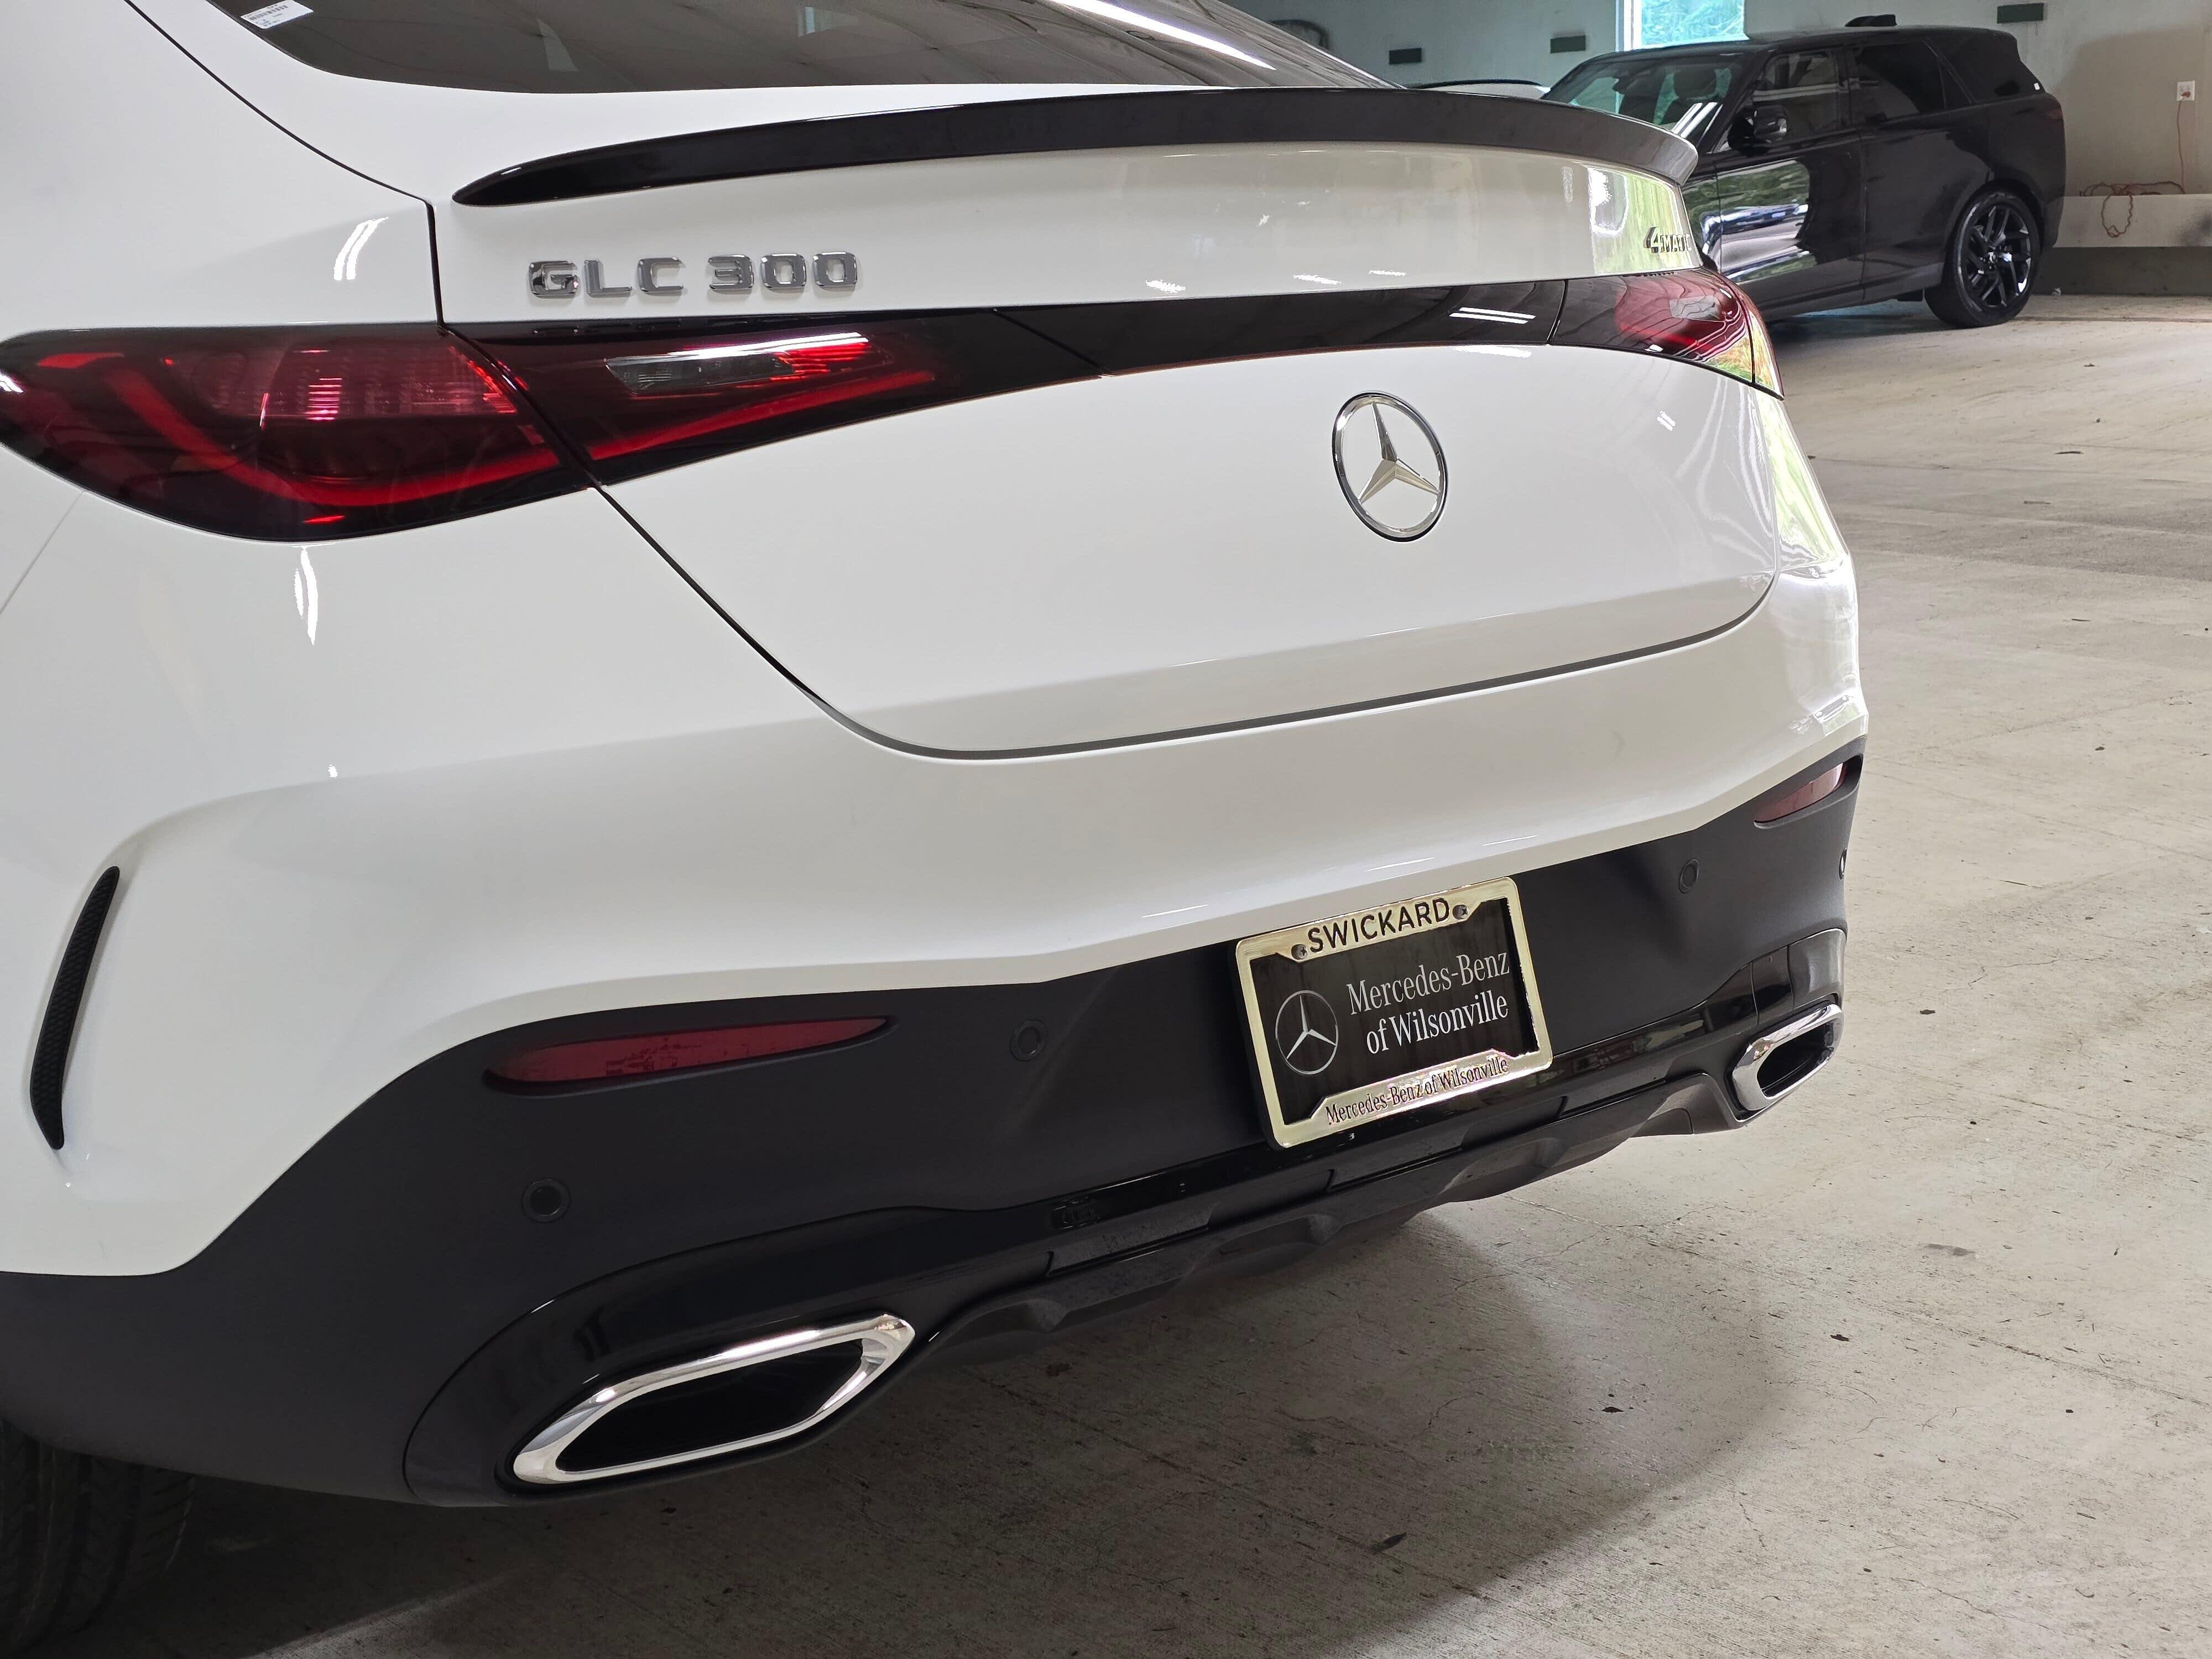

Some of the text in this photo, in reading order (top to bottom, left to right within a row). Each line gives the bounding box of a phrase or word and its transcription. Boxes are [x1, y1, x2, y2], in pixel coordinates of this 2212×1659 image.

[1644, 226, 1692, 253] 4MATIC
[529, 252, 858, 297] GLC 300
[1307, 898, 1450, 952] SWICKARD
[1347, 952, 1510, 1015] Mercedes-Benz
[1366, 990, 1509, 1054] of Wilsonville
[1326, 1056, 1508, 1125] Mercedes-Benz of Wilsonville
